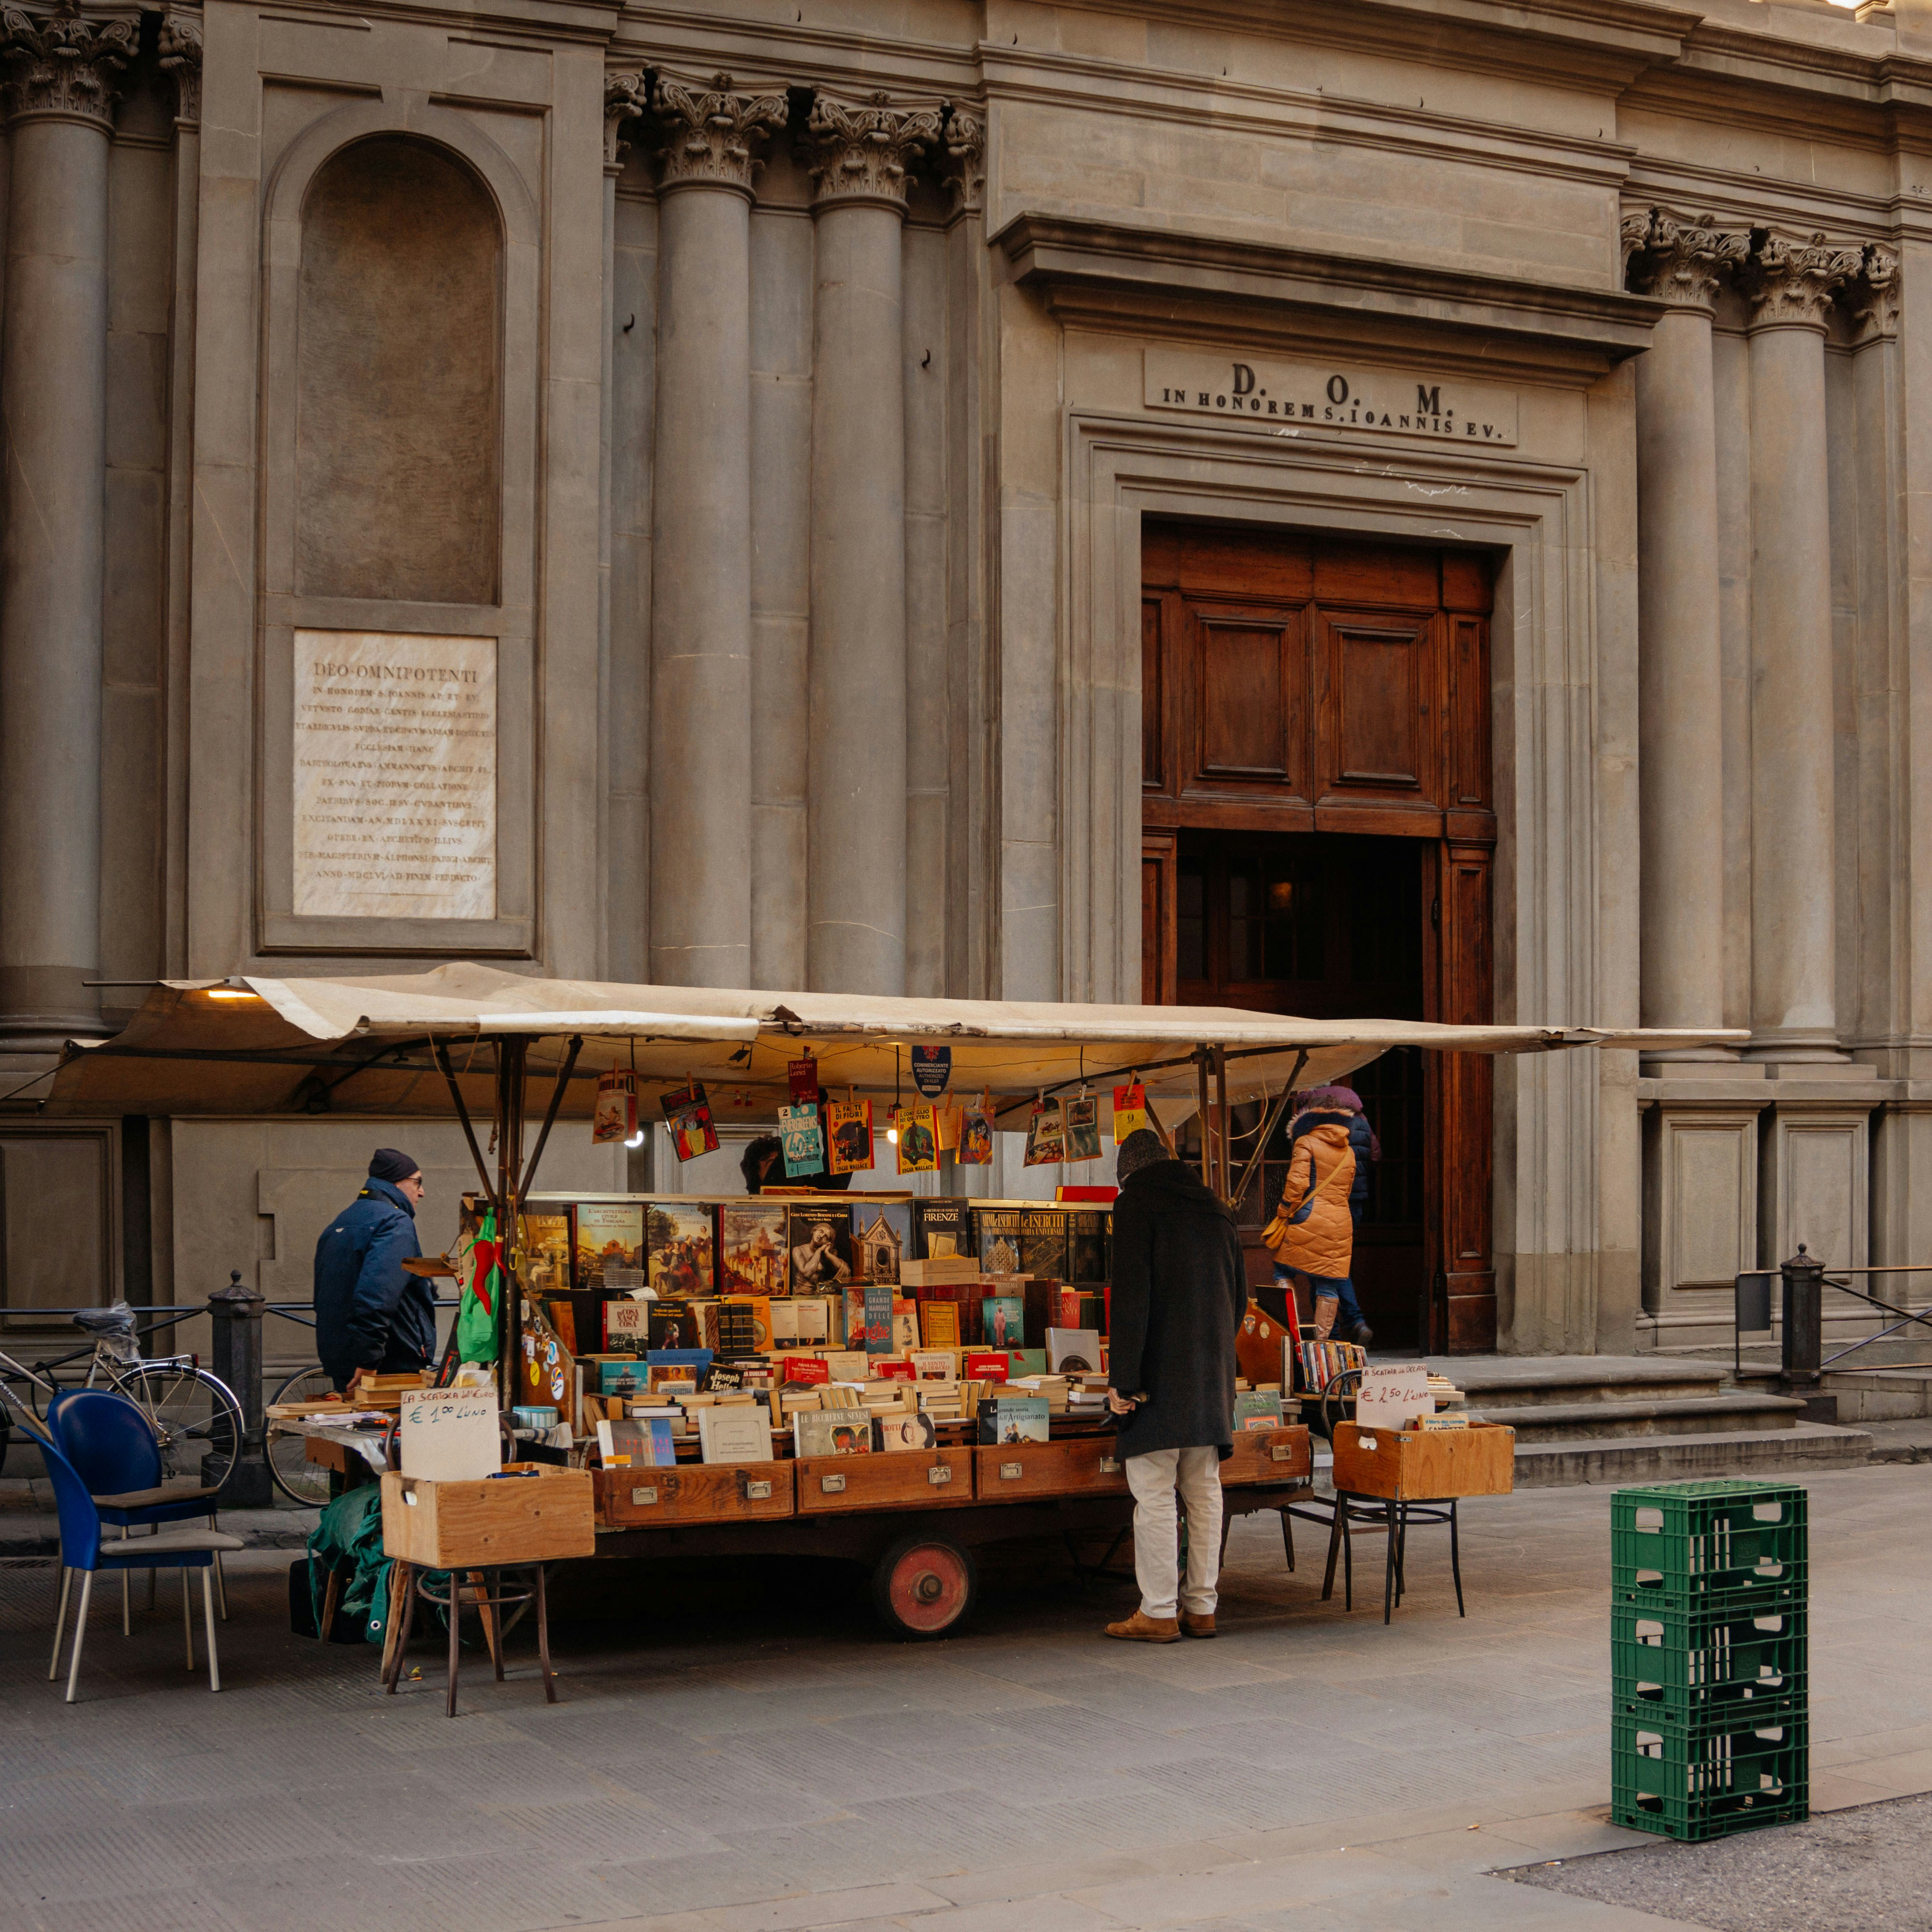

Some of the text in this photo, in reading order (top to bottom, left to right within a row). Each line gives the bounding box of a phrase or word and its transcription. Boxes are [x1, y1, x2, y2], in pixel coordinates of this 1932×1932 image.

[1232, 363, 1454, 417] D. O. M.
[1164, 388, 1186, 403] IN
[1198, 392, 1315, 418] HONOREM
[782, 1108, 788, 1117] 2
[843, 1104, 862, 1112] FATE
[843, 1110, 862, 1119] FIORI
[849, 1163, 867, 1171] WALLACE
[924, 1213, 959, 1221] FIRENZE
[1029, 1214, 1064, 1228] ESERCITI
[852, 1321, 890, 1345] droghe
[710, 1370, 740, 1383] Joseph
[402, 1391, 458, 1404] LA SCATOLA
[801, 1411, 868, 1424] LE BICCHERNE SENESI
[998, 1413, 1045, 1422] dell'Artigianato
